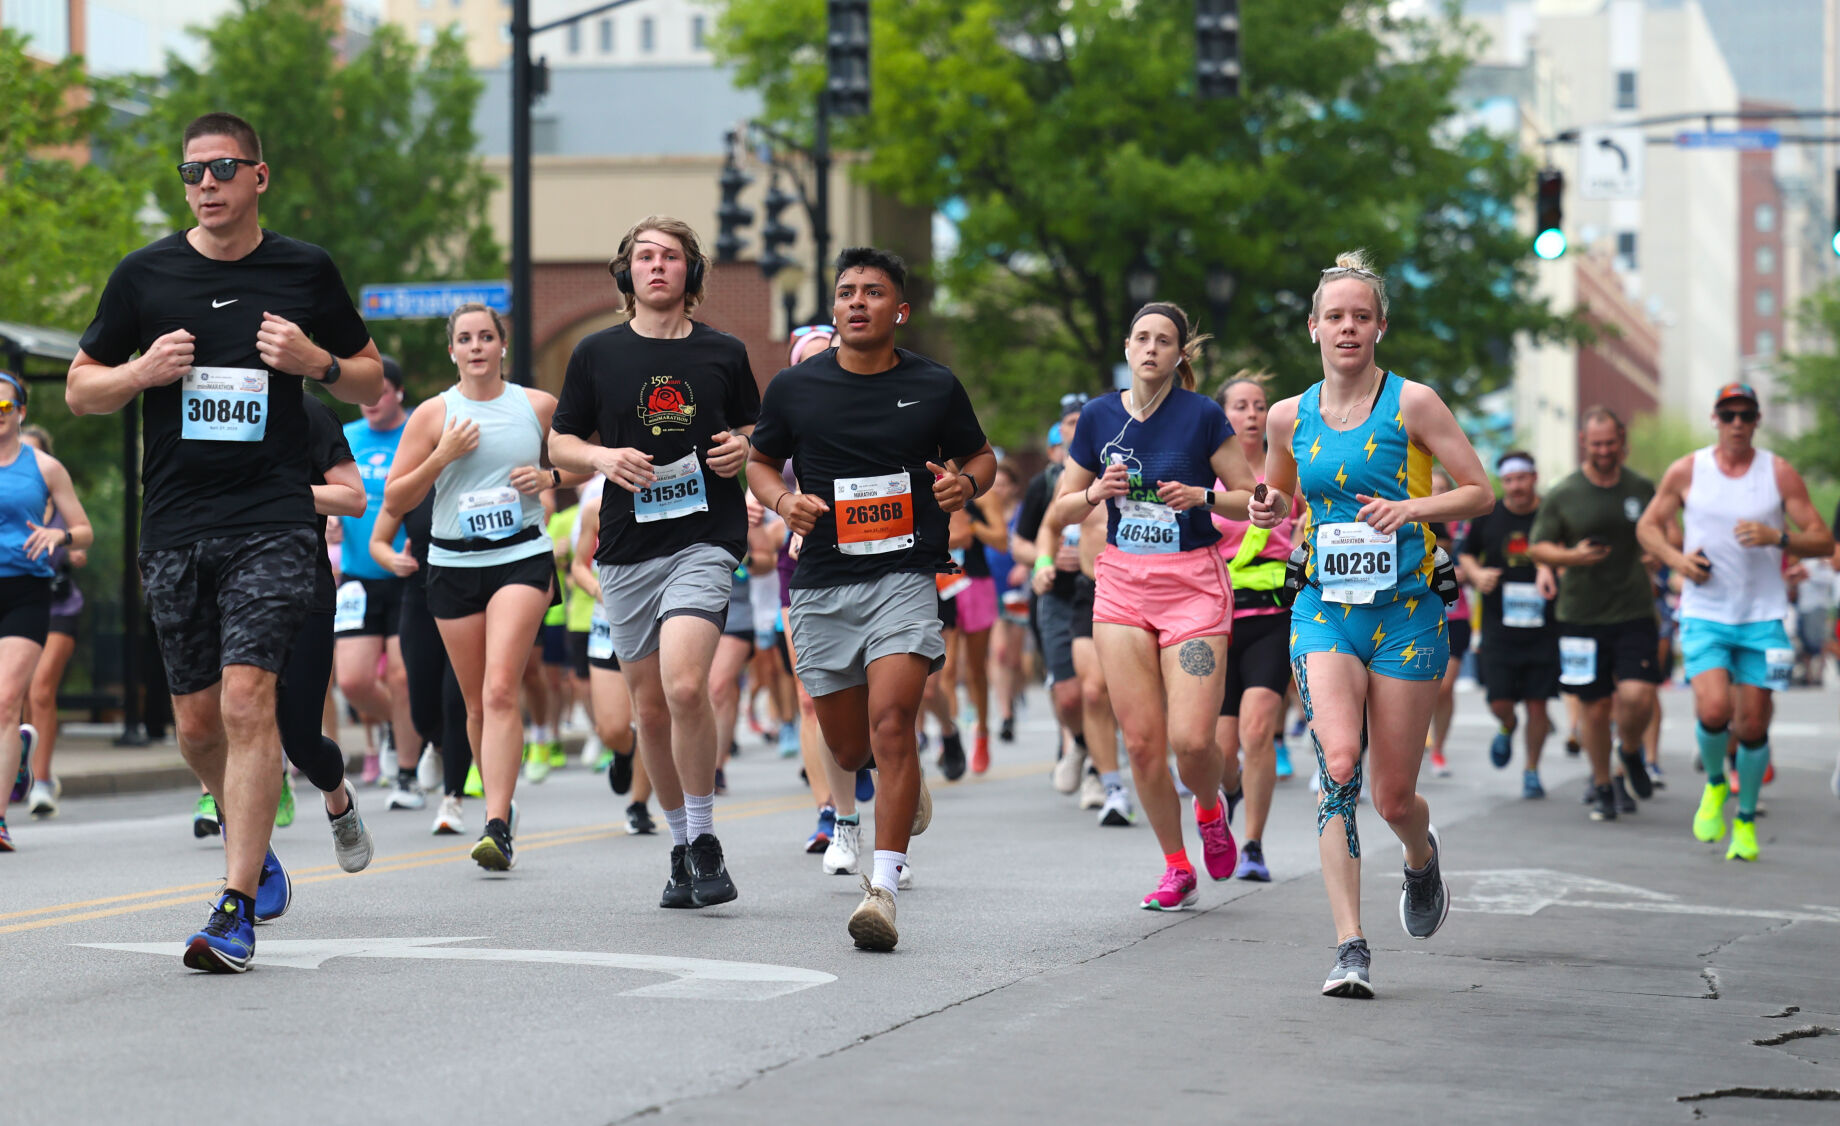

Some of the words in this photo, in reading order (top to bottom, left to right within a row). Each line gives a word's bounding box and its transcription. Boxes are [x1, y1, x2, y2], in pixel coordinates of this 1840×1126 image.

[188, 398, 261, 424] 3084C
[640, 479, 699, 504] 3153C
[853, 490, 878, 498] MARATHON
[466, 509, 515, 533] 1911B
[845, 501, 904, 525] 2636B
[1120, 523, 1174, 544] 4643C
[1324, 551, 1391, 576] 4023C
